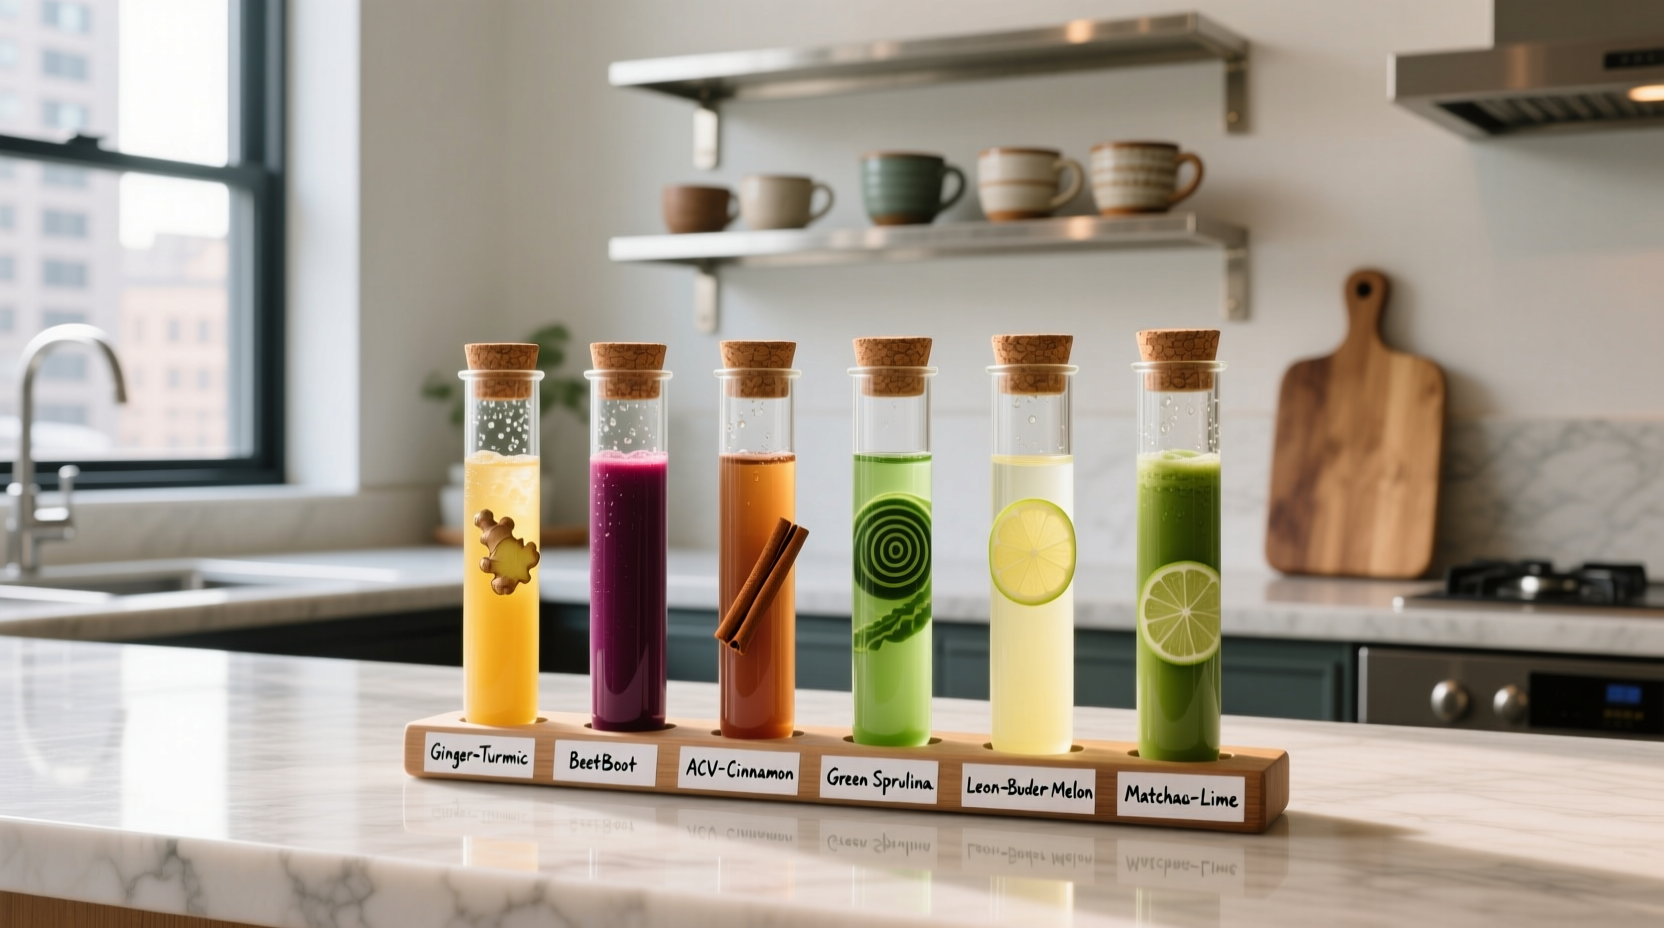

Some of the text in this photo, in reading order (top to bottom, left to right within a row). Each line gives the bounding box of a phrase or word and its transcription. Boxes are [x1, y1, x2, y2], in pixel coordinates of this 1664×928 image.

[431, 743, 529, 770] Ginger-Turmic
[569, 751, 638, 773] BeetBoot
[686, 758, 794, 780] ACV-Cinnamon
[827, 767, 935, 796] Green Sprulina
[967, 776, 1094, 800] Leon-Buder Melon
